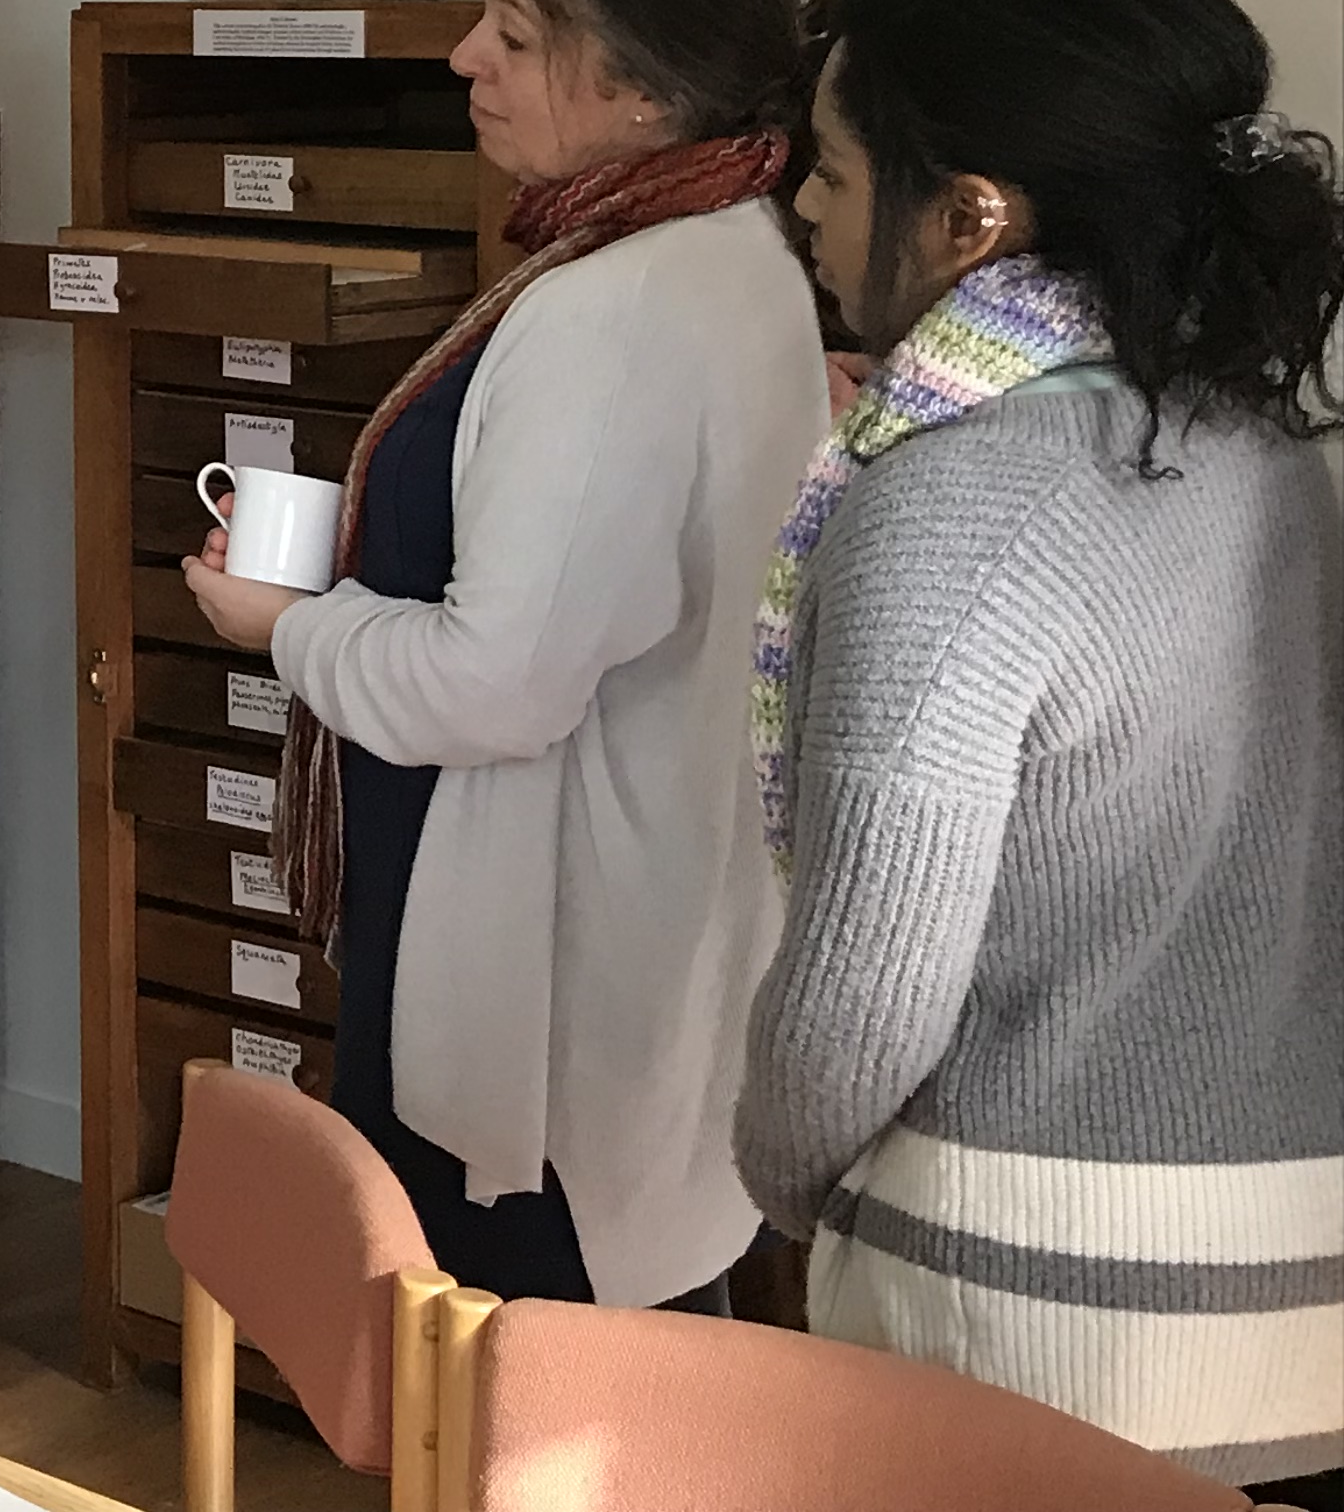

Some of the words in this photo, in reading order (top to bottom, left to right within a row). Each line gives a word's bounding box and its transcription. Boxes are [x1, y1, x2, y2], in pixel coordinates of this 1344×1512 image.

[226, 157, 282, 168] Carnivora
[53, 257, 91, 267] Primates
[236, 944, 287, 965] Squamata
